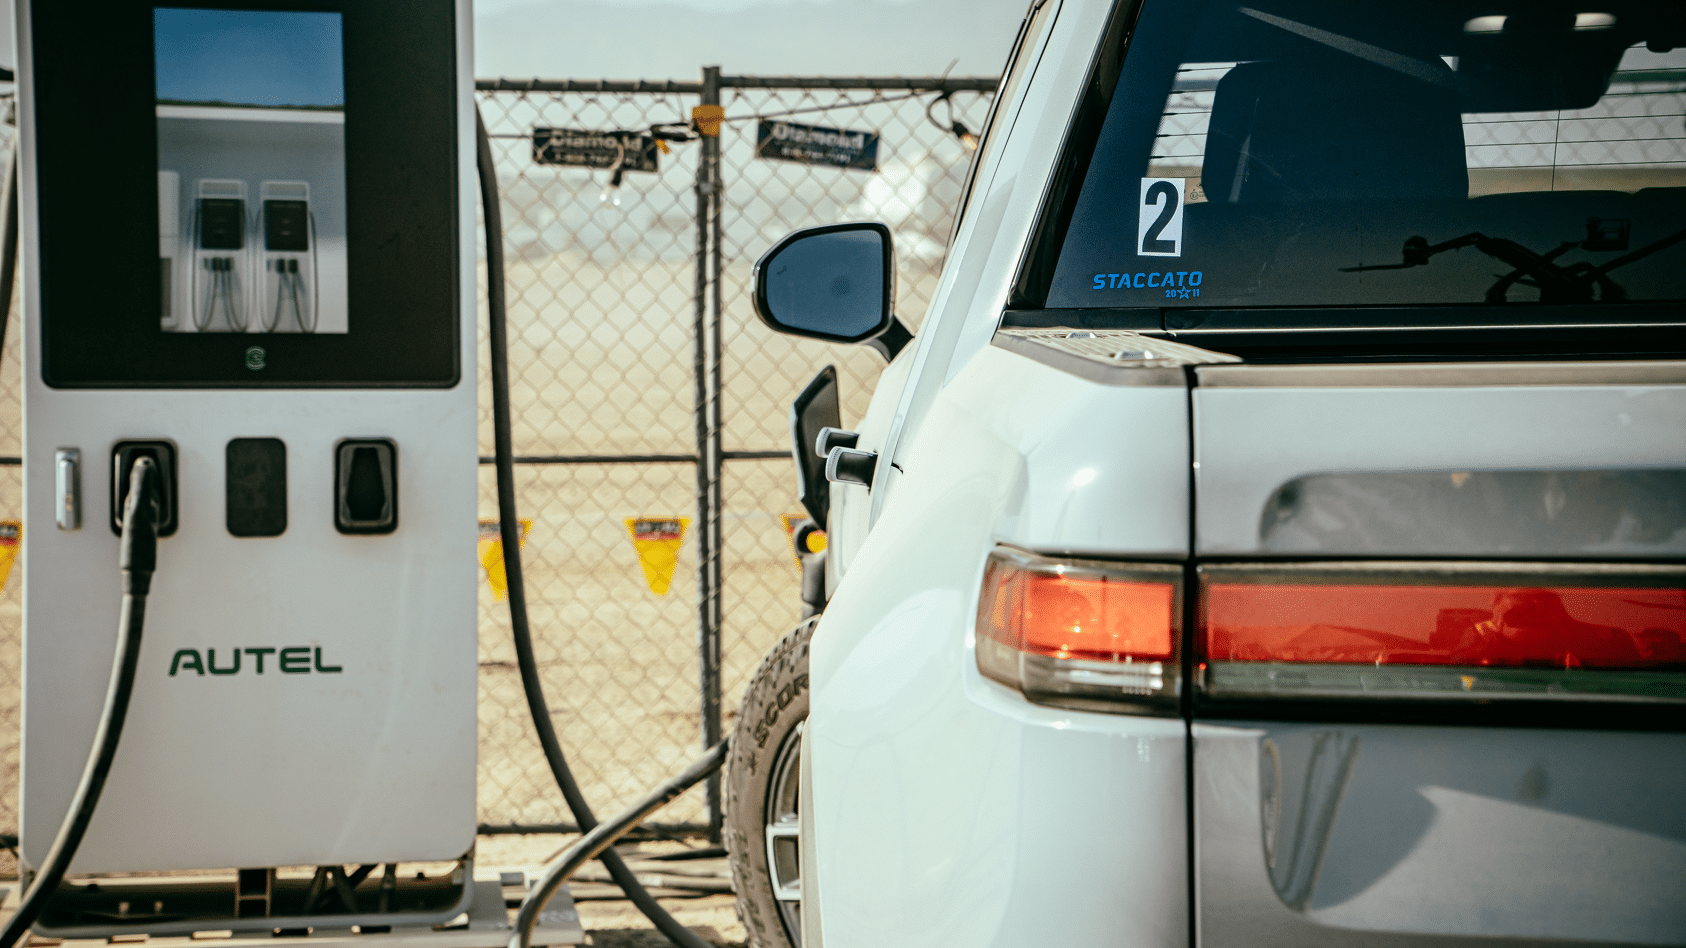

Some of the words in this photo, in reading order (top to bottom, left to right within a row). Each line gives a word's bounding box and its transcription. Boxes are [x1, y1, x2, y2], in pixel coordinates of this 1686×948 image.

[1142, 180, 1179, 254] 2
[1092, 271, 1203, 290] STACCATO
[168, 646, 343, 677] AUTEL
